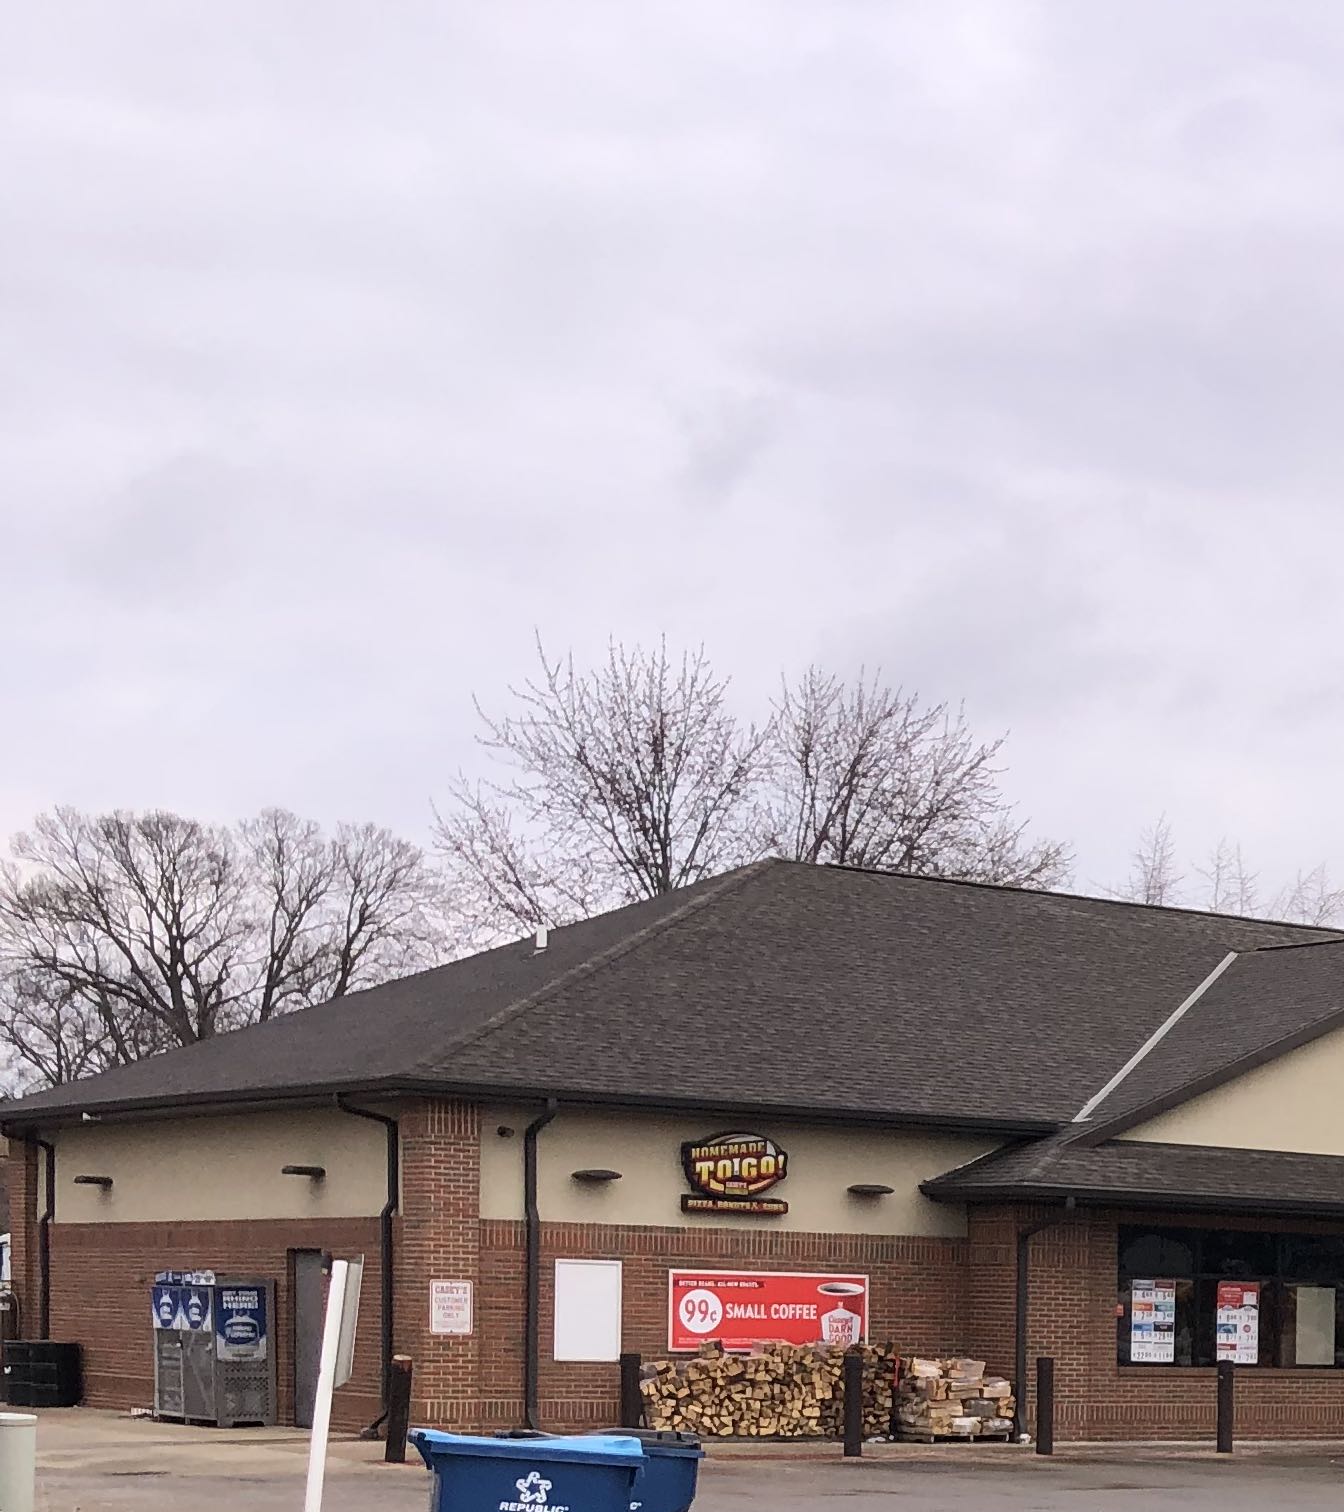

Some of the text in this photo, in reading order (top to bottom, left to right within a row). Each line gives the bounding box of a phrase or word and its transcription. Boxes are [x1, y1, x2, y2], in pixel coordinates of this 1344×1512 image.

[691, 1142, 765, 1158] HOMEMADE
[726, 1303, 817, 1320] SMALL COFFEE
[829, 1324, 853, 1333] DARN
